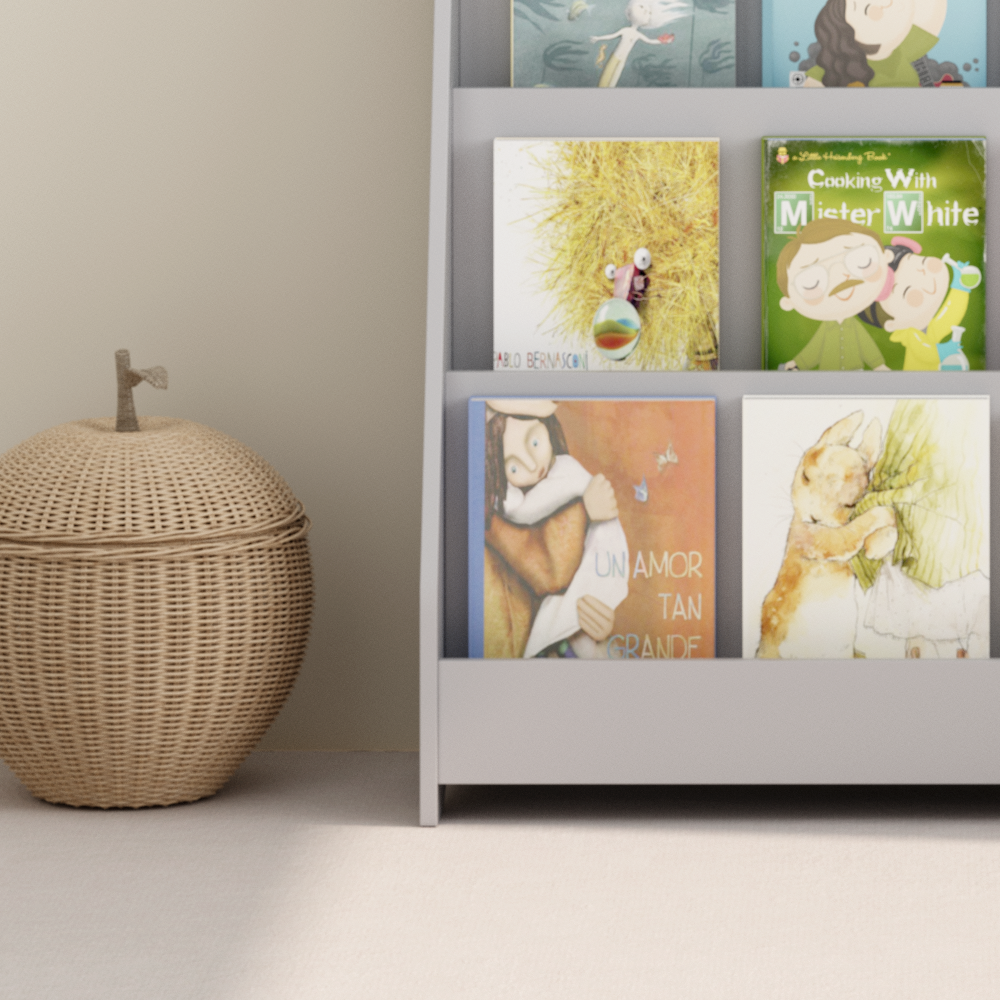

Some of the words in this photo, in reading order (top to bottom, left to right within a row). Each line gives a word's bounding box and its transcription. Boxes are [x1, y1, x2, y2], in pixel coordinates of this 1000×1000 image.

[807, 168, 883, 193] Cooking
[884, 168, 937, 189] With
[781, 200, 881, 227] Mister
[886, 200, 980, 227] White
[527, 350, 588, 370] BERNASCONI
[595, 551, 625, 578] UN
[632, 550, 703, 579] AMOR
[658, 593, 702, 621] TAN
